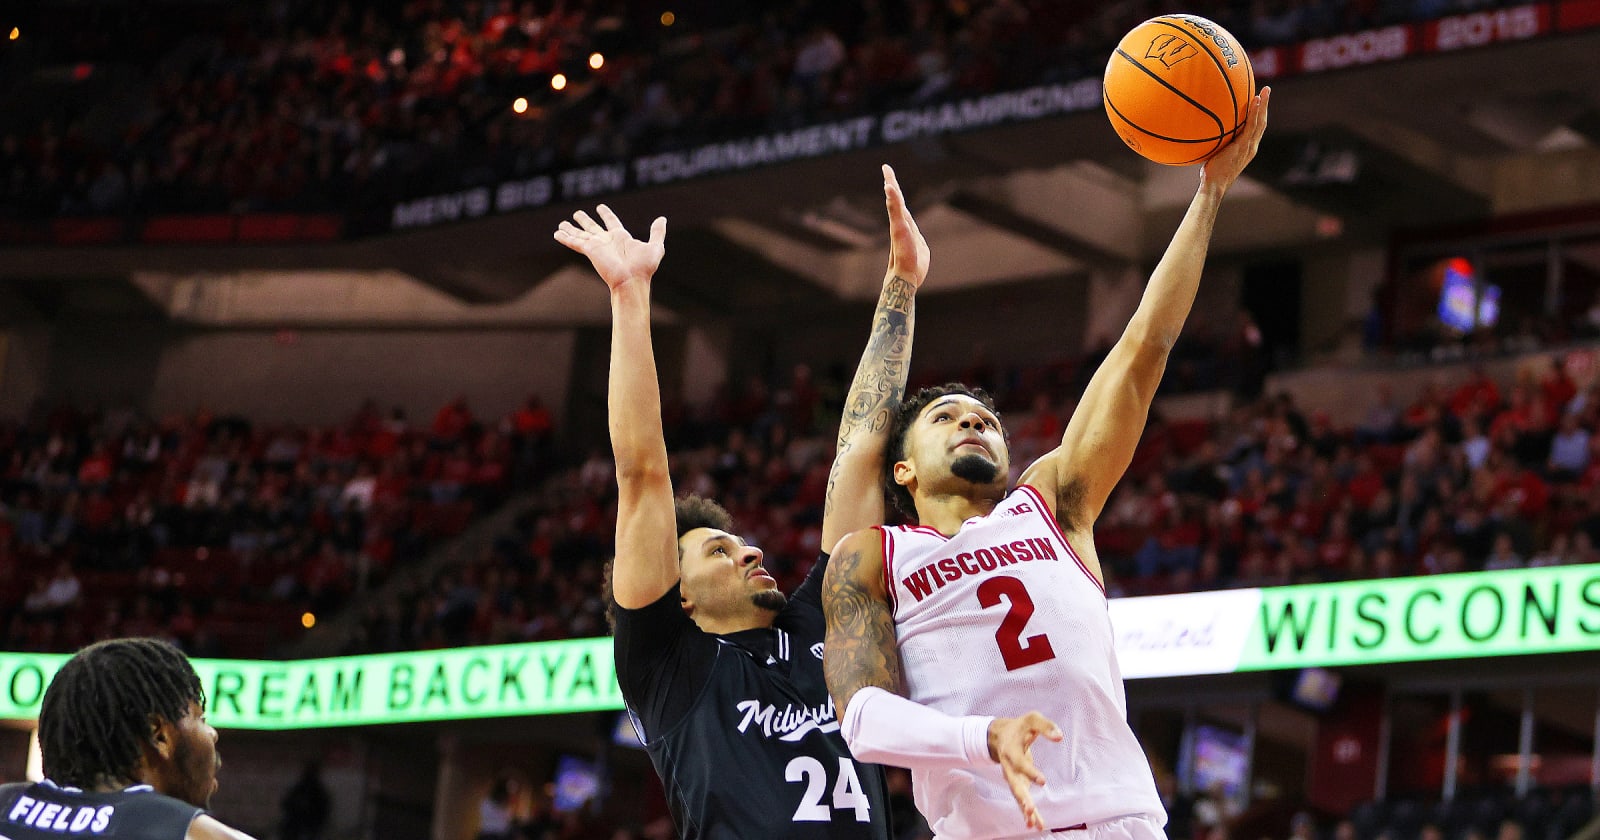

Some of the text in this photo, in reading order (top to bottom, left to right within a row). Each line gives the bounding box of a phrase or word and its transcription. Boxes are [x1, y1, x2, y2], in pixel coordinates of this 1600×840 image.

[1436, 5, 1539, 50] 2015
[392, 187, 491, 228] MEN'S
[496, 176, 553, 212] BIG
[560, 164, 627, 198] TEN
[634, 115, 875, 184] TOURNAMENT
[902, 537, 1058, 602] WISCONSIN
[976, 575, 1056, 672] 2
[211, 665, 364, 718] REAM
[387, 651, 619, 711] BACKYA
[8, 796, 115, 833] FIELDS
[784, 755, 871, 823] 24
